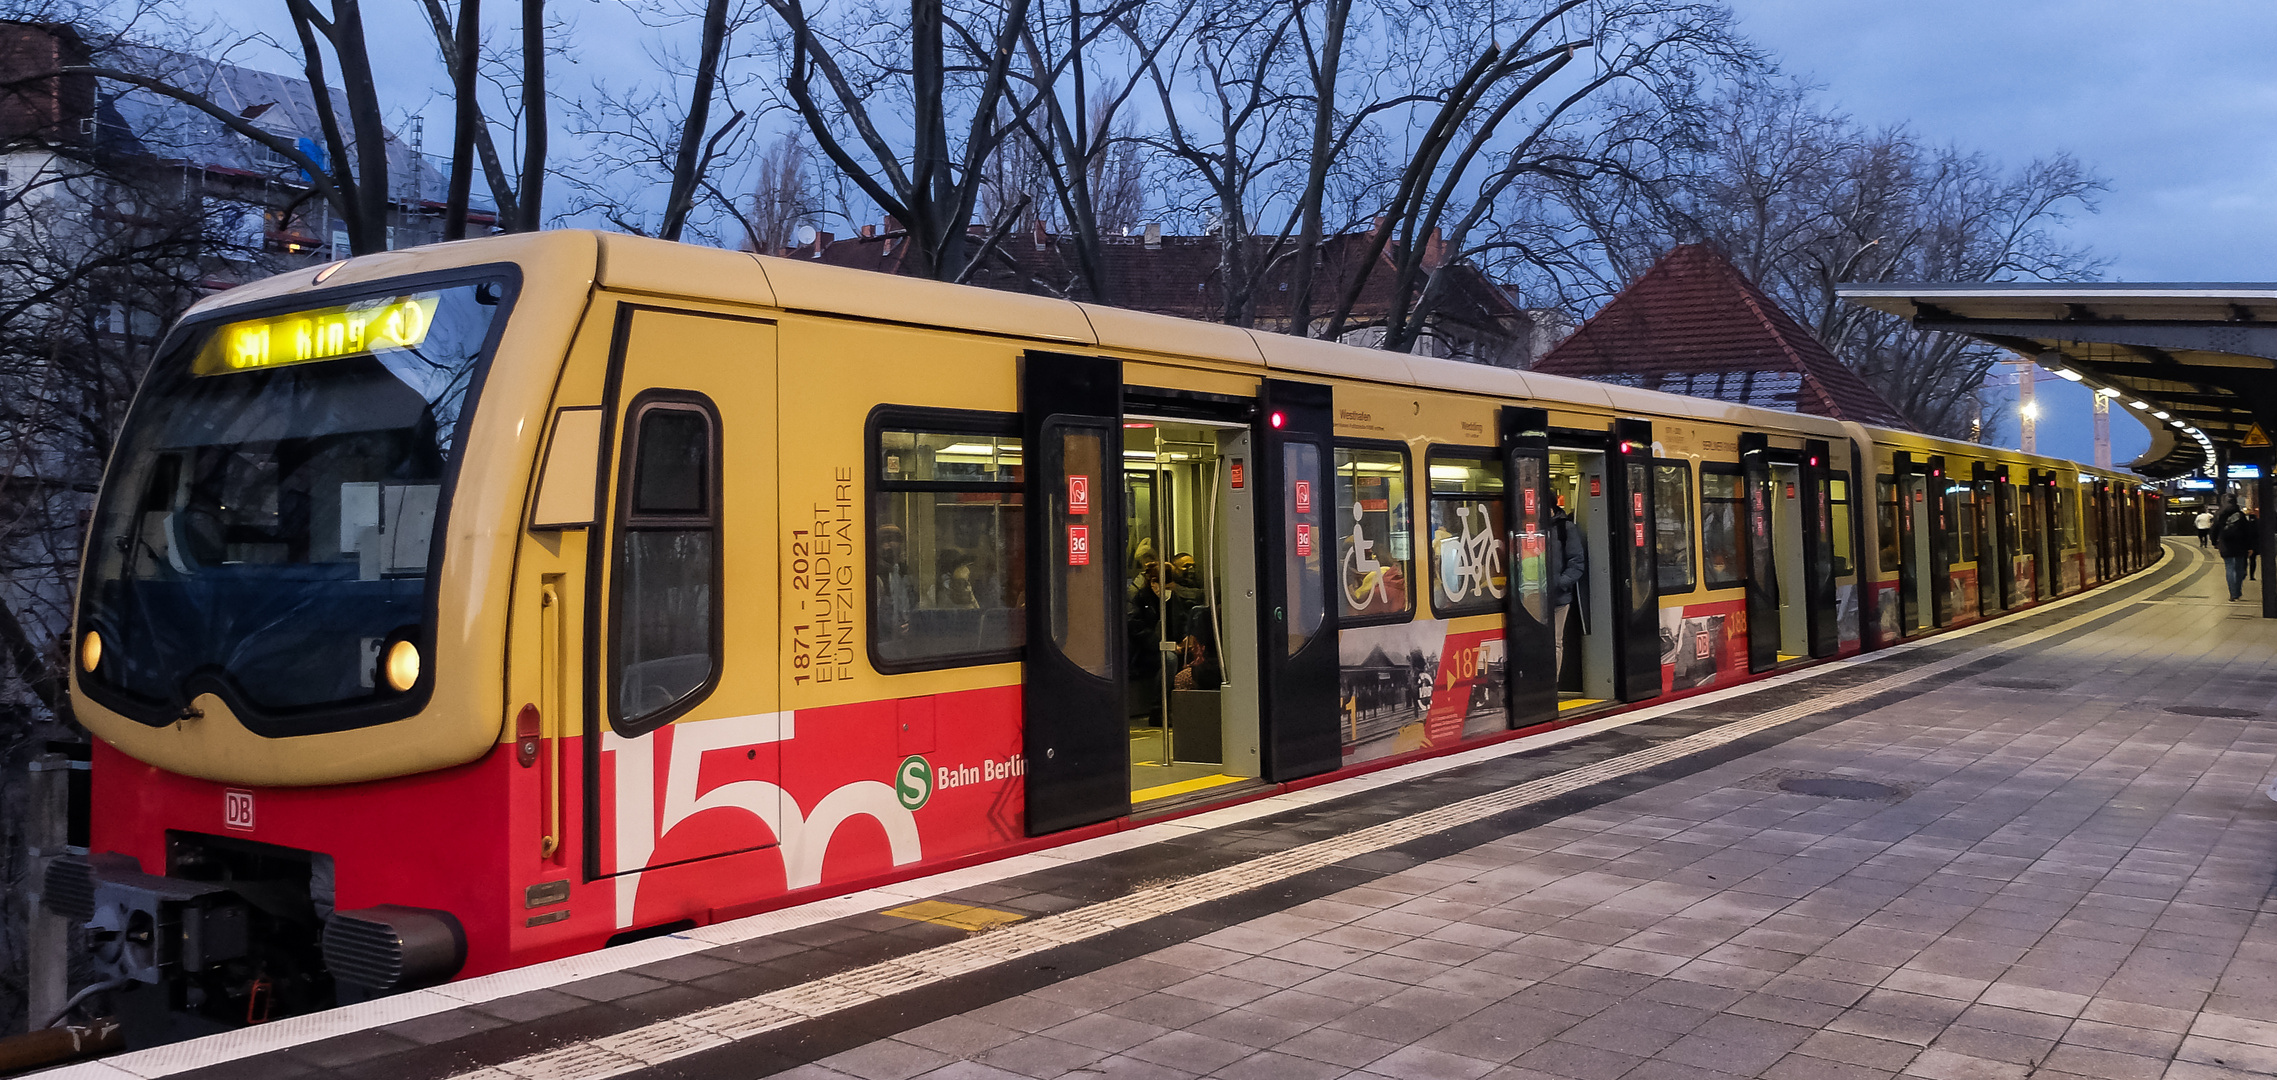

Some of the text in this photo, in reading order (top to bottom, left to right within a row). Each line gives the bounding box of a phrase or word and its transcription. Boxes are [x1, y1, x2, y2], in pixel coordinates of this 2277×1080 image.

[296, 317, 366, 360] Ring
[793, 530, 809, 590] 2021
[1072, 537, 1085, 551] 3G
[1299, 533, 1309, 544] 3G
[814, 502, 832, 683] EINHUNDERT
[834, 466, 854, 681] FÜNFZIG JAHRE
[1730, 610, 1747, 634] 188
[794, 625, 810, 686] 1871
[1452, 645, 1491, 680] 1877
[1696, 633, 1709, 657] DB
[901, 760, 928, 806] S
[938, 763, 980, 790] Bahn
[227, 793, 252, 826] DB
[602, 710, 922, 929] 150
